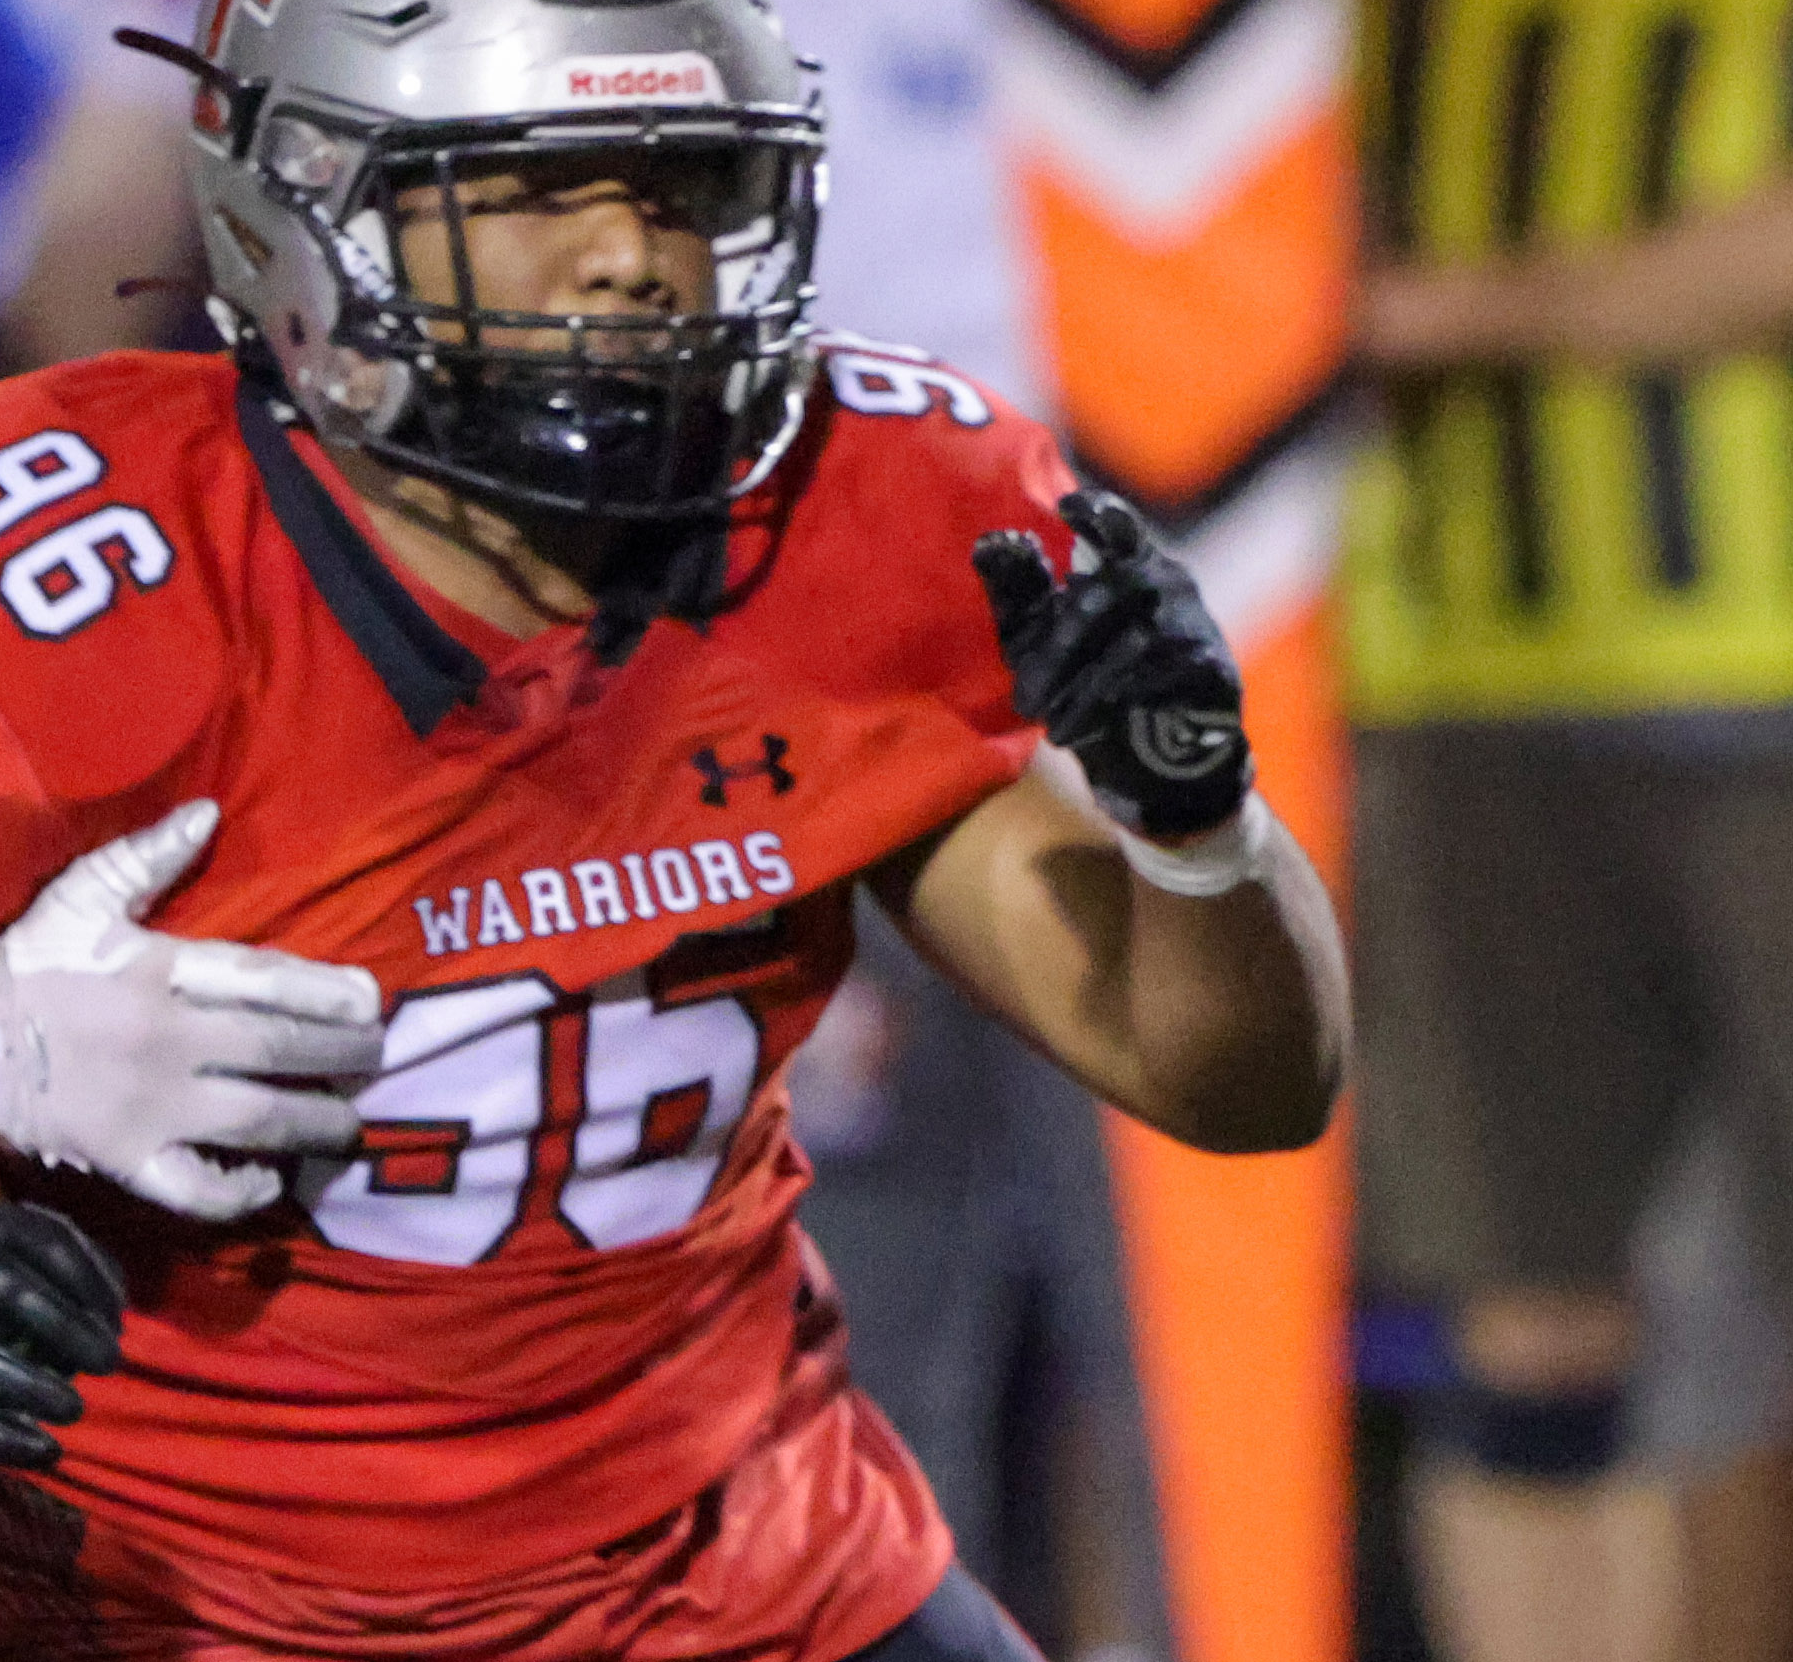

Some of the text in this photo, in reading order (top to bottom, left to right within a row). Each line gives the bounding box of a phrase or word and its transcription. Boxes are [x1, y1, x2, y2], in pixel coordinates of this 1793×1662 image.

[569, 68, 704, 96] Riddell
[811, 328, 993, 427] 9
[413, 831, 797, 956] WARRIORS
